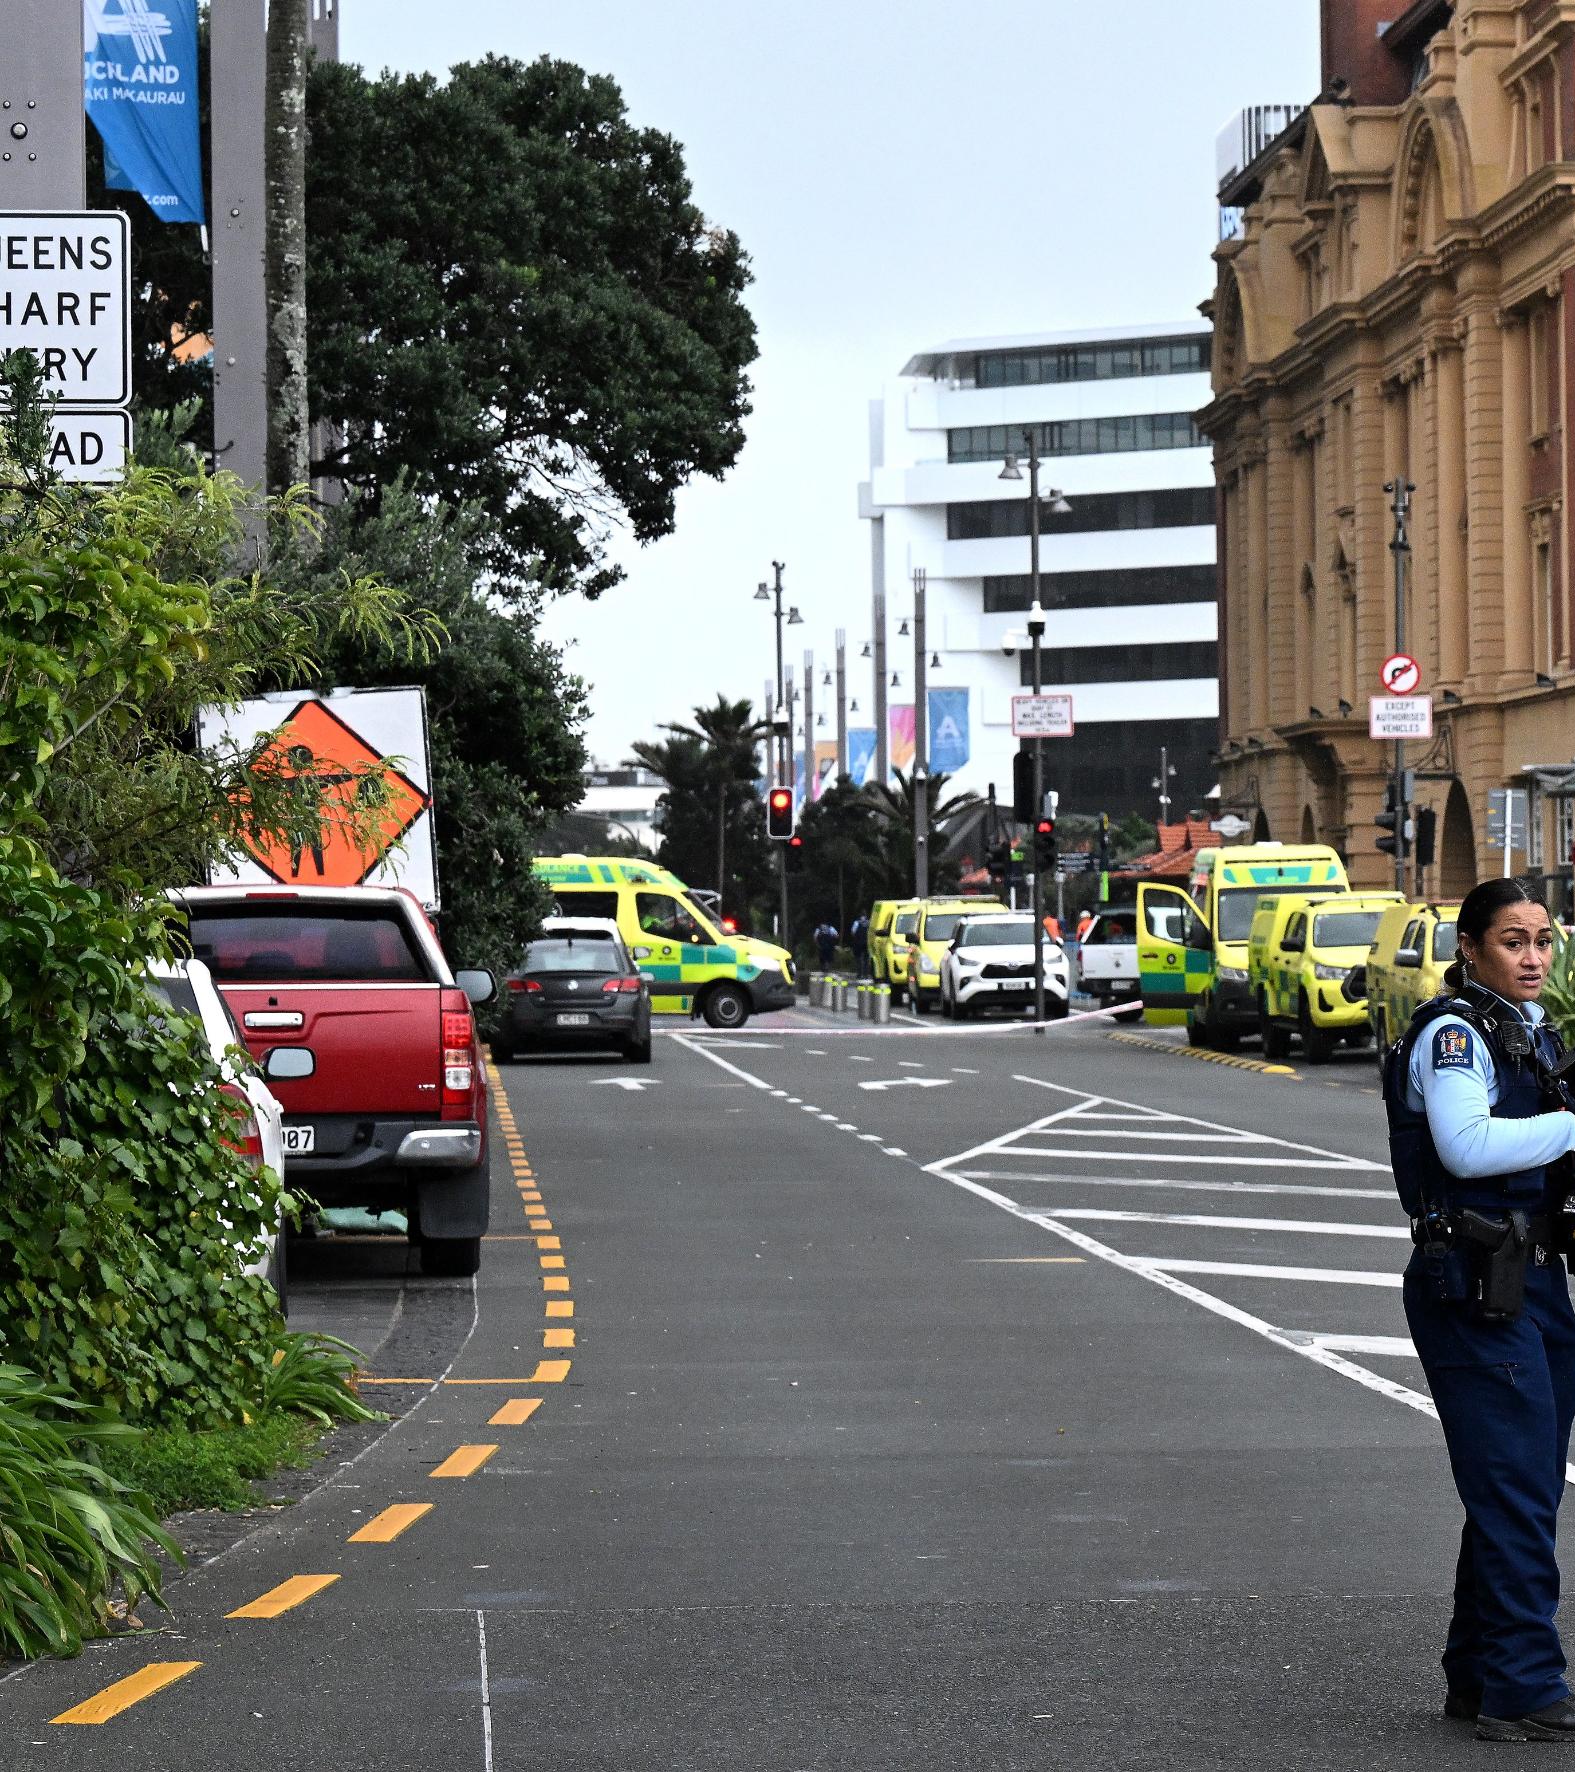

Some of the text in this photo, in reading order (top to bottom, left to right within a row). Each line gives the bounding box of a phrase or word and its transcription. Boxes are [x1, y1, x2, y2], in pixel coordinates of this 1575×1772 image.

[0, 235, 113, 270] EENS
[1385, 701, 1415, 711] EXCEPT
[1376, 712, 1427, 722] AUTHORISED
[1382, 723, 1419, 733] VEHICLES
[1437, 1057, 1470, 1066] POLICE
